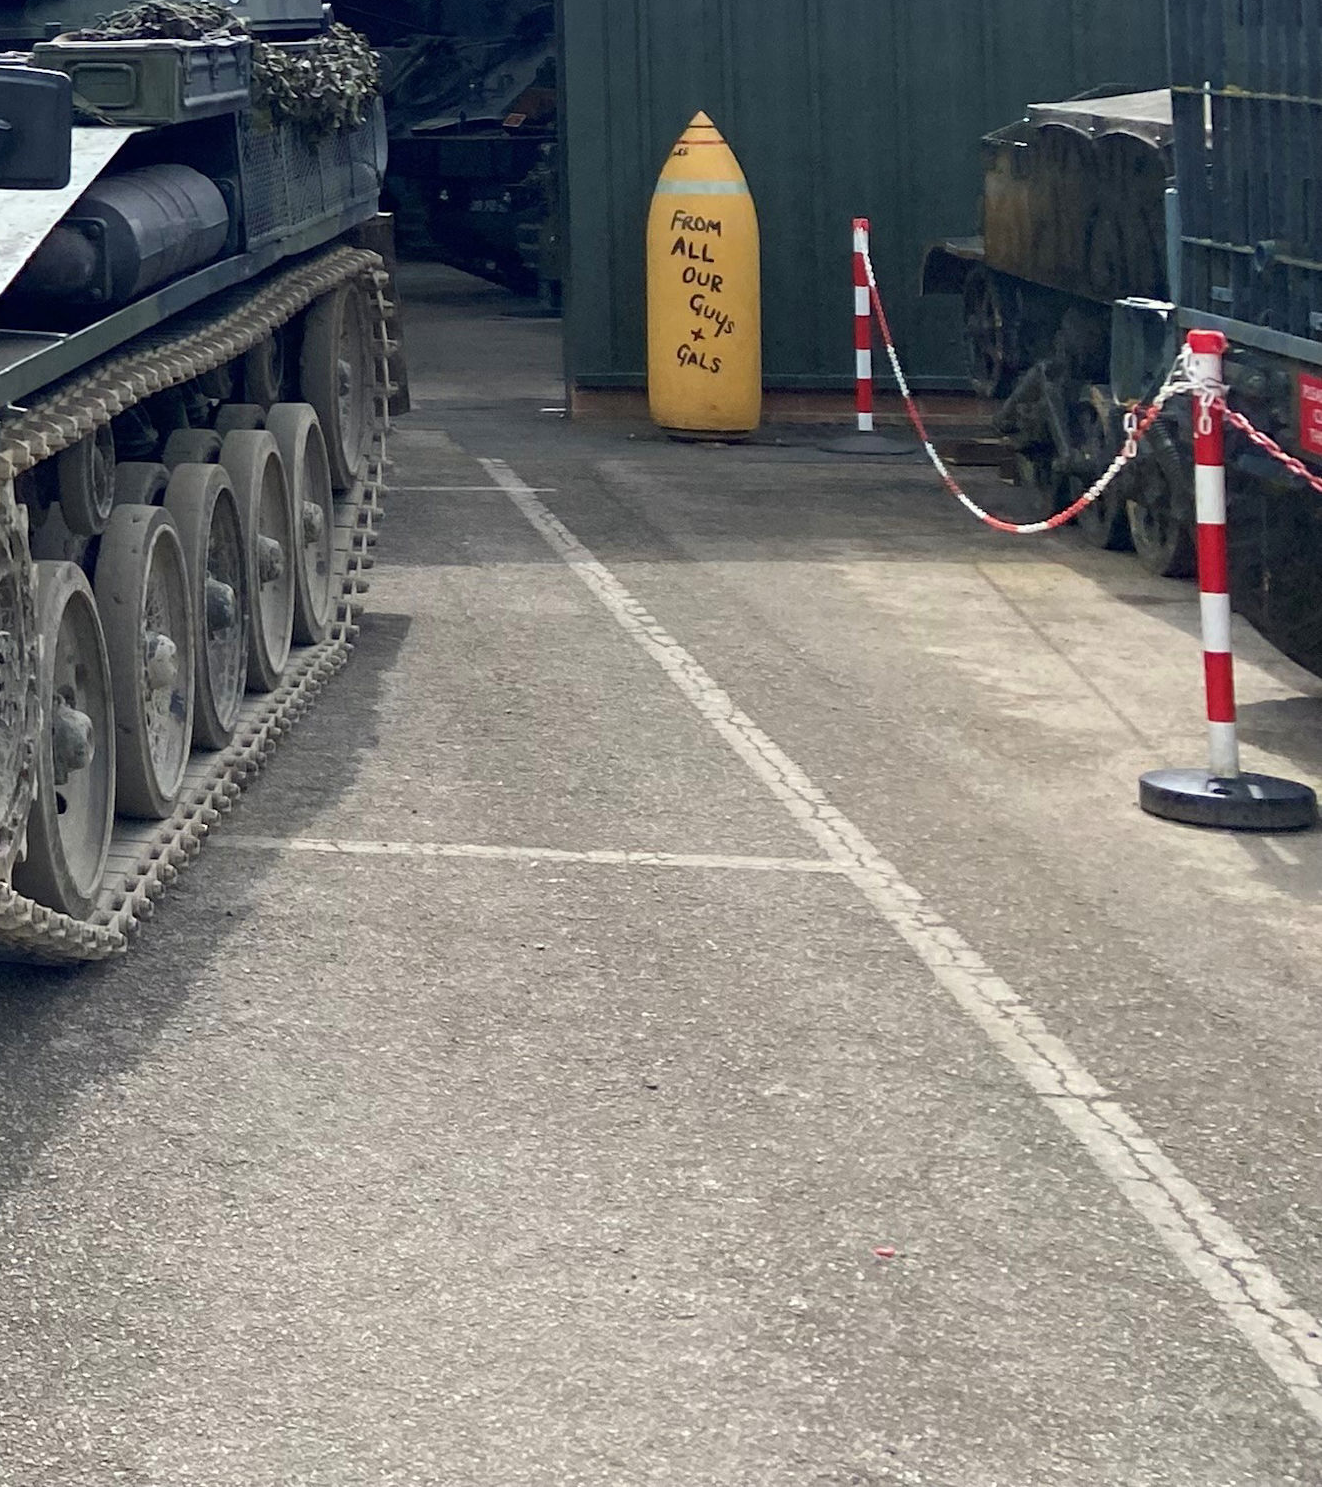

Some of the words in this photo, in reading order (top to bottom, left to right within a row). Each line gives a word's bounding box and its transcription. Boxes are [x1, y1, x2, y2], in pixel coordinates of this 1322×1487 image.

[671, 209, 721, 238] FROM
[671, 236, 714, 263] ALL
[682, 266, 723, 293] OUR
[677, 343, 722, 374] GALS
